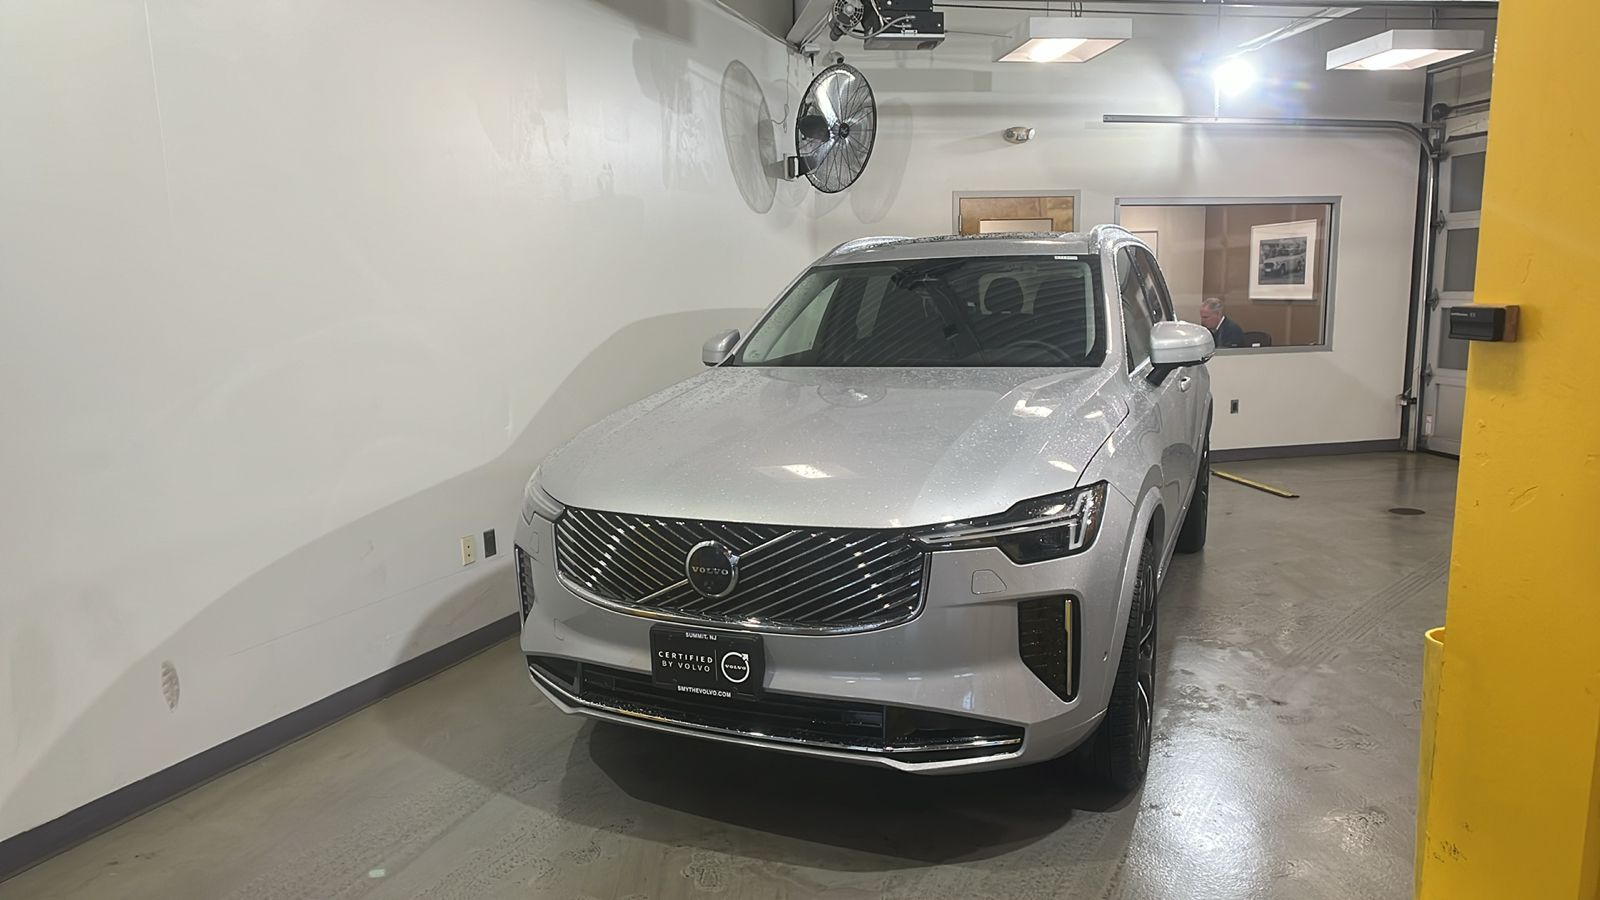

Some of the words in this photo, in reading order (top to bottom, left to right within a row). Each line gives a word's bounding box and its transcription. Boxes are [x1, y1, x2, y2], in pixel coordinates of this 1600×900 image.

[691, 566, 729, 576] VOLVO
[658, 651, 713, 663] CERTIFIED
[678, 662, 710, 672] VOLVO
[677, 685, 732, 697] SMYTHEVOLVO.COM
